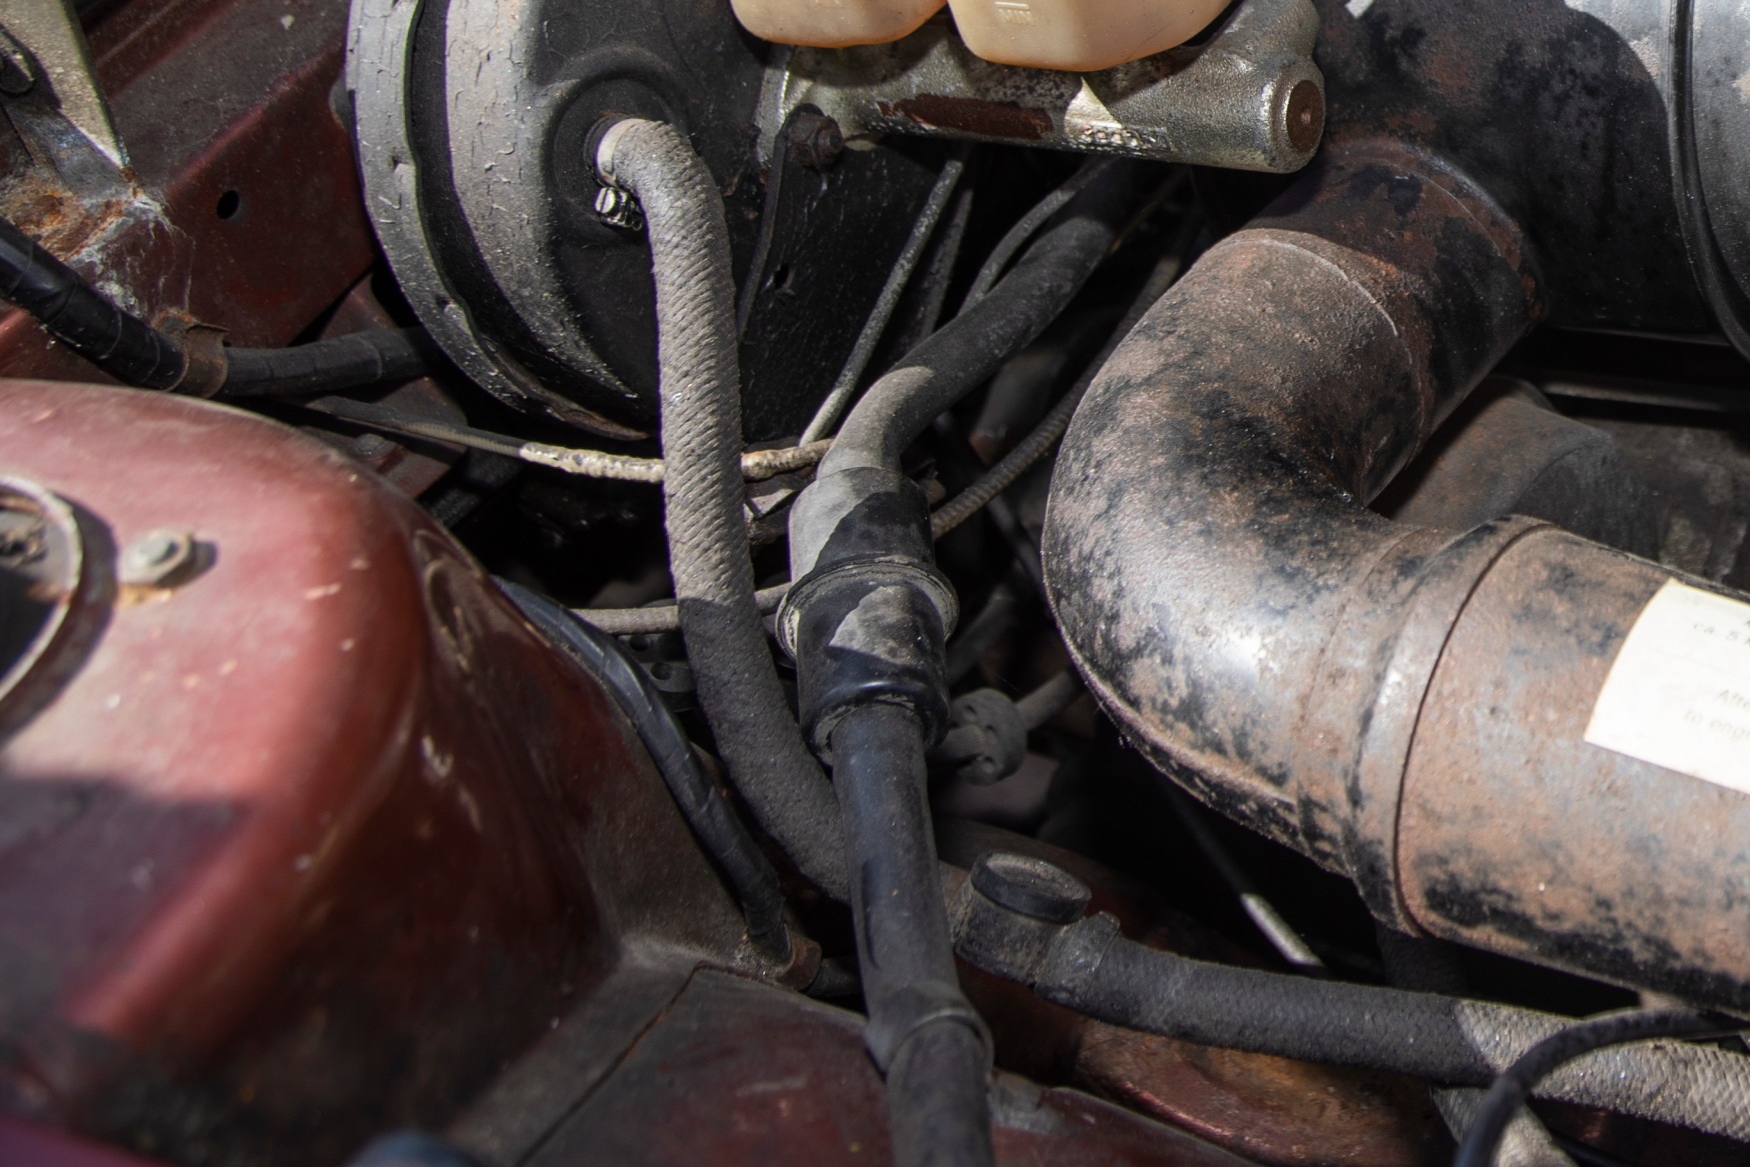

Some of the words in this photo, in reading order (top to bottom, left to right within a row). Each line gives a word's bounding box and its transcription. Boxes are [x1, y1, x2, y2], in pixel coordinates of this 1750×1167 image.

[997, 8, 1036, 26] MIN
[1727, 631, 1738, 641] 5
[1683, 708, 1704, 725] to
